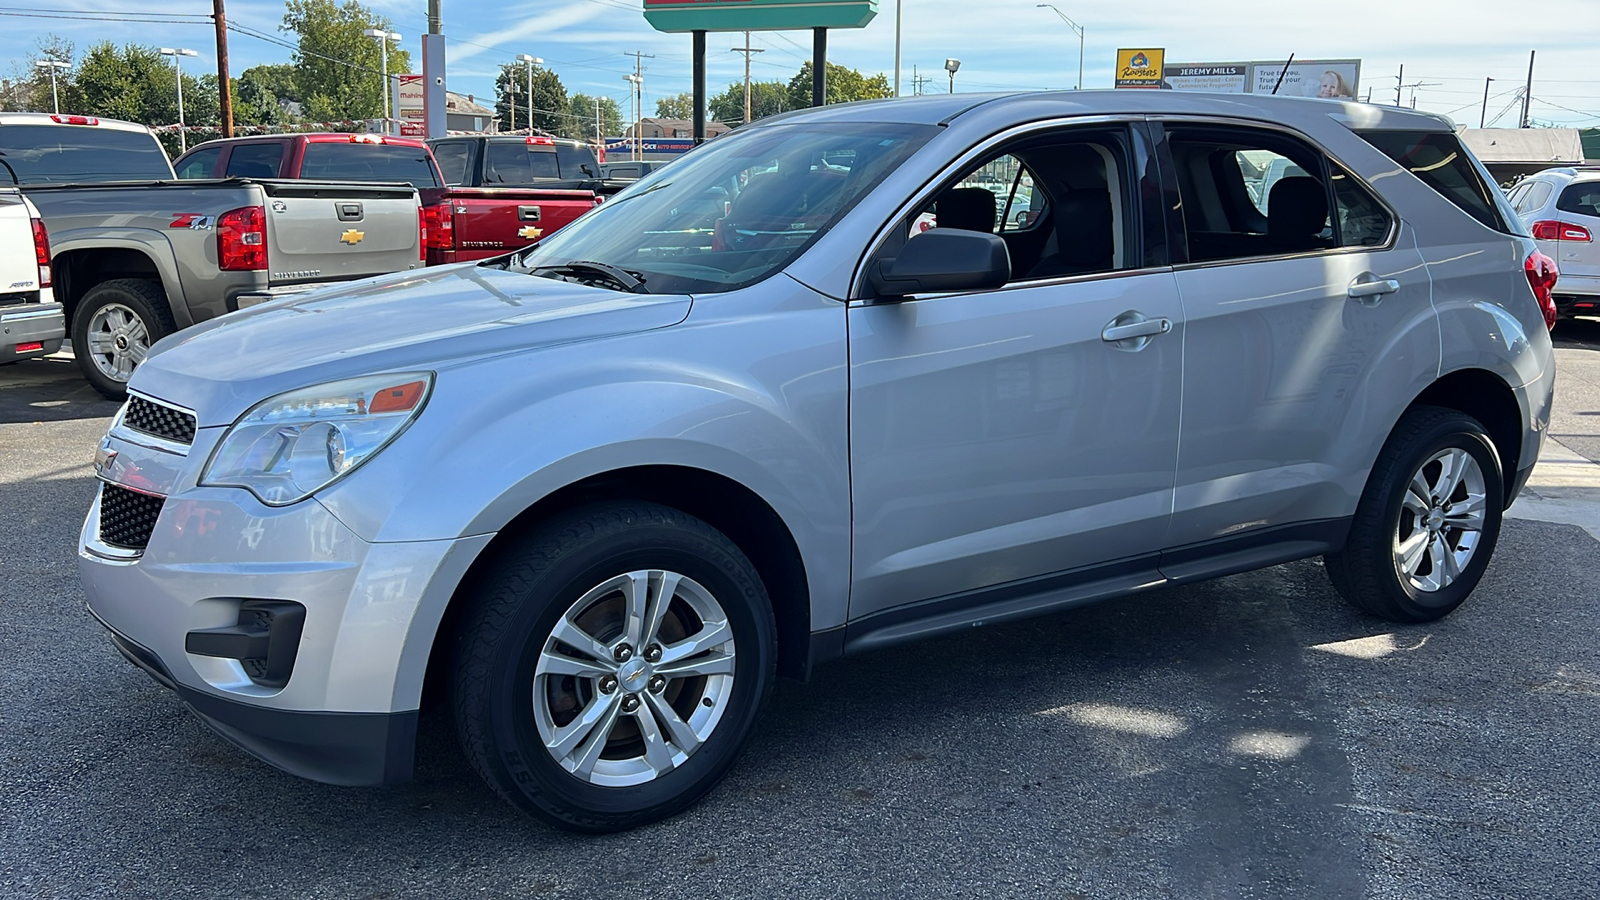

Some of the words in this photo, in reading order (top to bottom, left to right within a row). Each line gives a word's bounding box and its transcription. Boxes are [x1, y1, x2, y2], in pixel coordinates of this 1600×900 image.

[1121, 66, 1157, 78] Roosters
[1180, 68, 1211, 76] JEREMY
[1212, 67, 1237, 75] MILLS
[169, 213, 216, 231] Z71
[274, 269, 321, 279] SILVERADO
